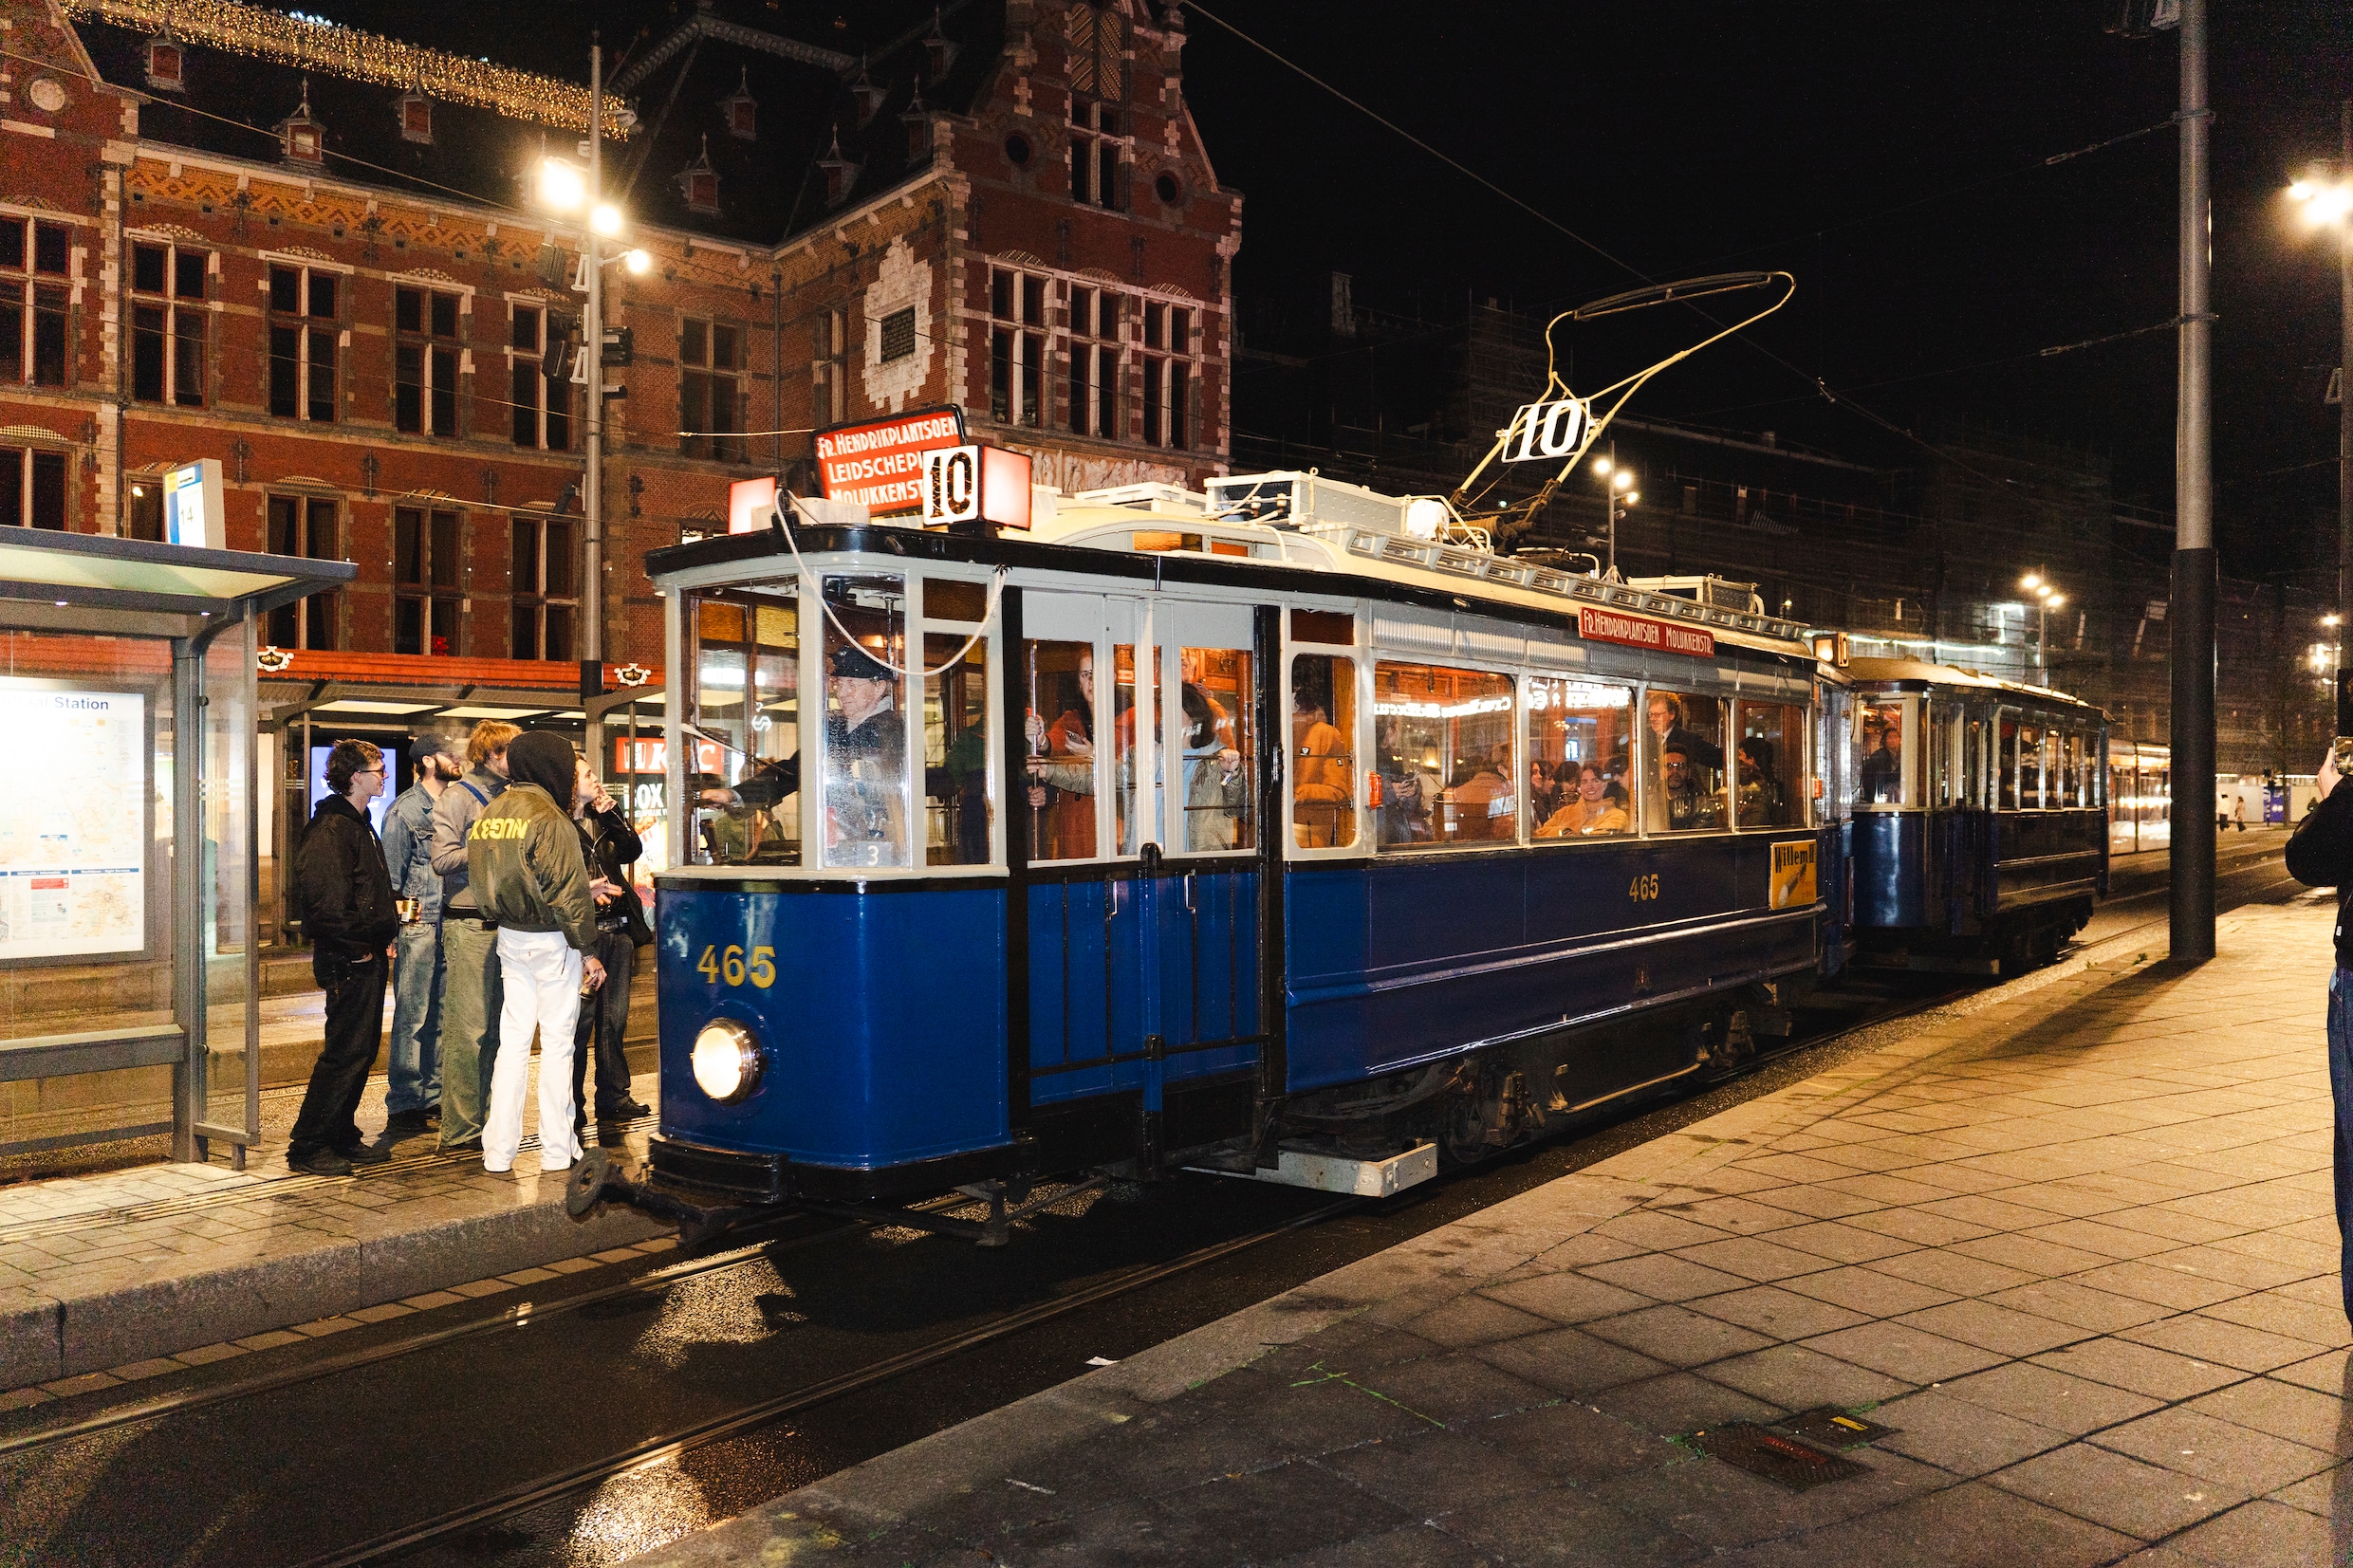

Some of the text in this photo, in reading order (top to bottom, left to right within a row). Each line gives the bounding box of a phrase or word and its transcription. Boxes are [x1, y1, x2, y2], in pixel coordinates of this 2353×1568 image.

[1513, 399, 1583, 459] 10
[929, 451, 973, 519] 10
[54, 696, 109, 710] Station
[649, 743, 716, 771] KC
[867, 844, 880, 866] 3
[1774, 845, 1808, 874] Willem
[1628, 873, 1659, 903] 465
[696, 944, 777, 989] 465
